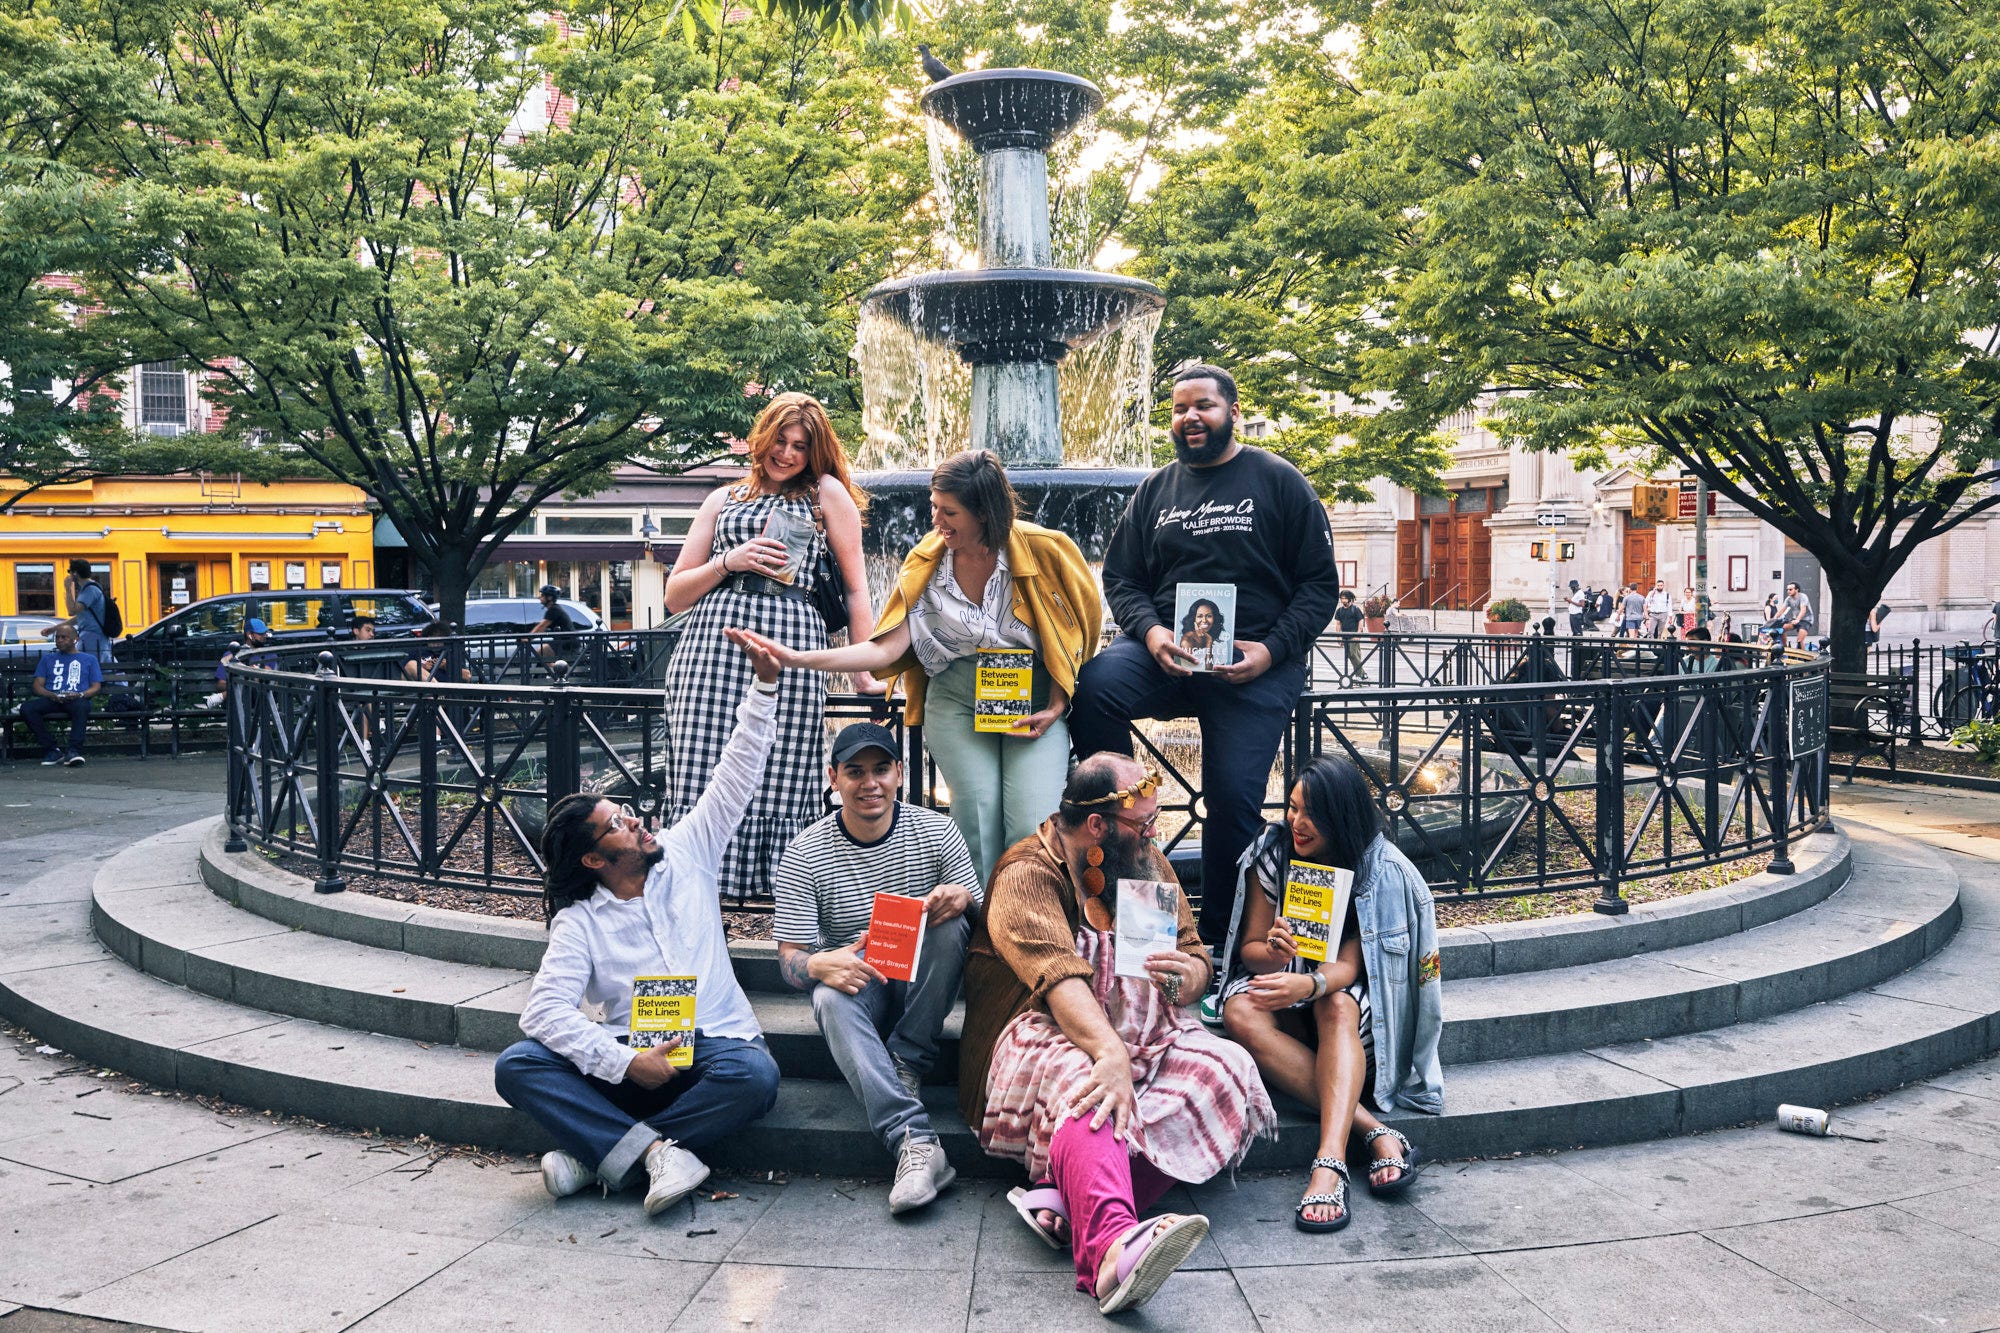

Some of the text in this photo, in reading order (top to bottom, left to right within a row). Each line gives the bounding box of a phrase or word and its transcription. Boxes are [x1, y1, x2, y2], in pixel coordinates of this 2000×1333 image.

[1192, 500, 1235, 520] Memory
[1183, 516, 1252, 530] KALIEF BROWDER
[1180, 589, 1231, 597] BECOMING
[981, 670, 1019, 679] Between
[981, 679, 1019, 687] the Lines
[1290, 885, 1322, 898] Between
[1289, 894, 1322, 907] the Lines
[1309, 943, 1324, 951] Cohen
[867, 957, 908, 968] Cheryl Strayed
[638, 999, 680, 1007] Between
[638, 1008, 680, 1016] the Lines
